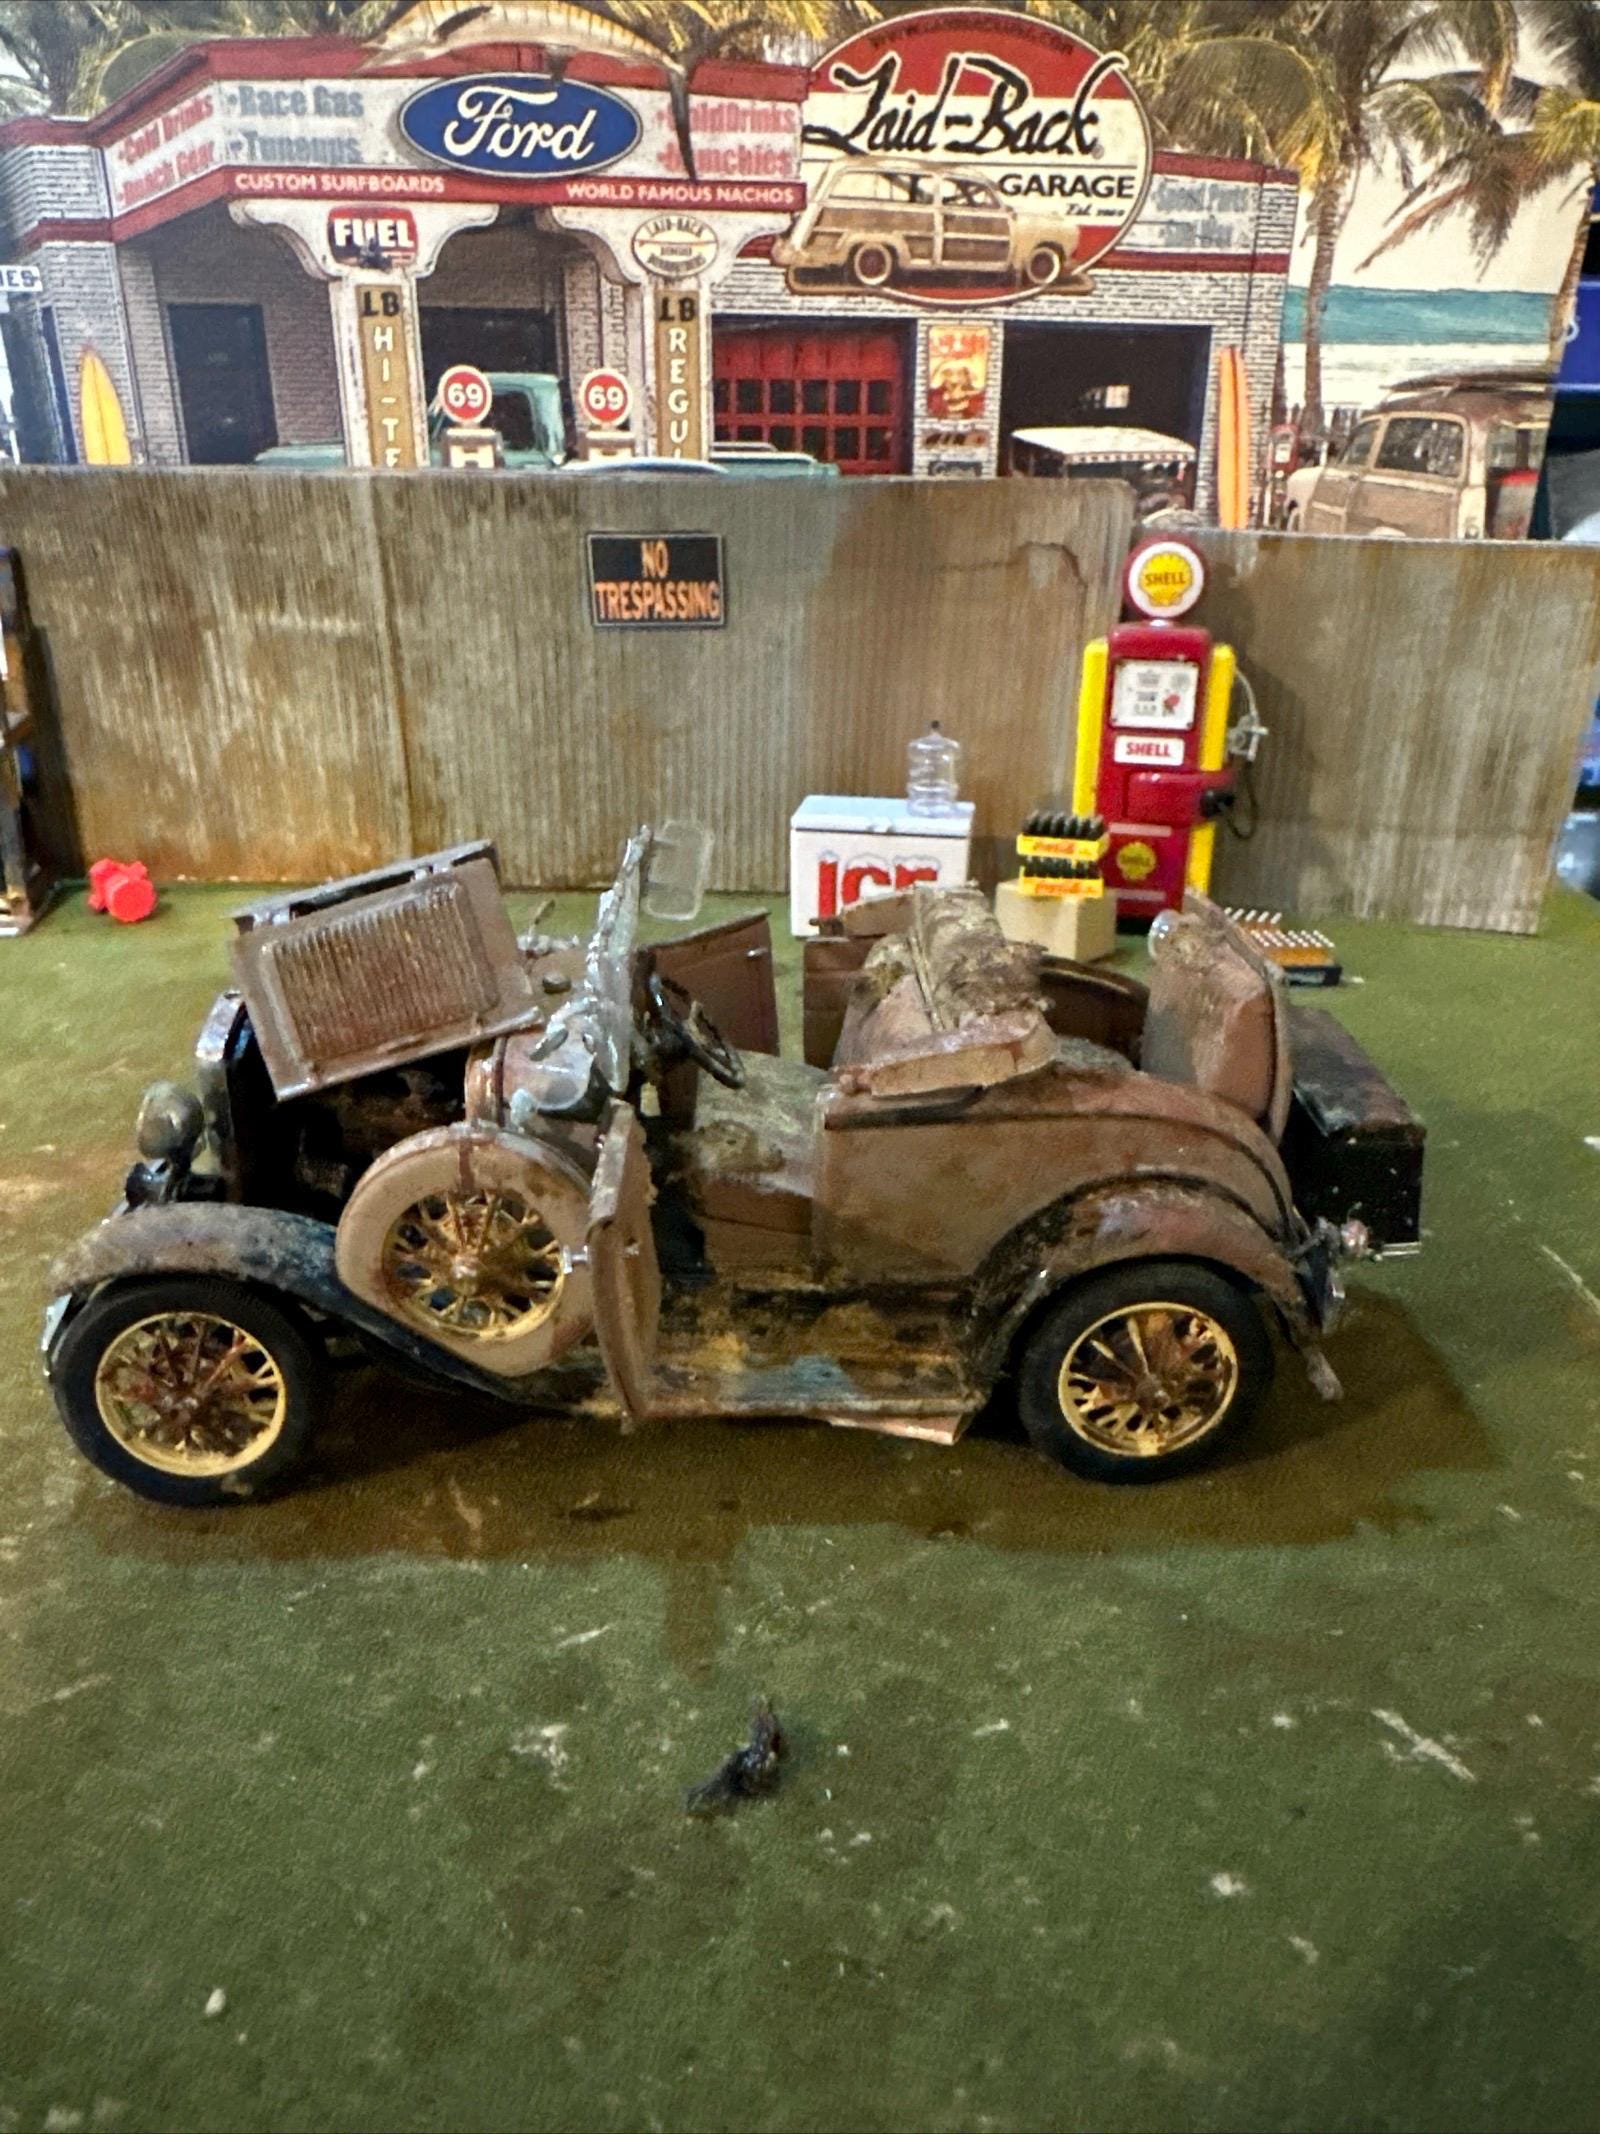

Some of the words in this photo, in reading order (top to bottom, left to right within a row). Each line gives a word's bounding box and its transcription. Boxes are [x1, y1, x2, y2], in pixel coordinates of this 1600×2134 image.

[239, 85, 307, 117] Race
[802, 54, 1127, 155] Laid-Back
[444, 85, 598, 160] Ford
[235, 174, 317, 190] CUSTOM
[321, 175, 445, 193] SURFBOARDS
[566, 183, 634, 200] WORLD
[638, 185, 713, 202] FAMOUS
[716, 187, 794, 204] NACHOS
[999, 174, 1135, 199] GARAGE
[333, 218, 414, 248] FUEL
[362, 291, 400, 317] LB
[660, 297, 697, 321] LB
[448, 382, 484, 408] 69
[588, 385, 625, 411] 69
[641, 540, 669, 578] NO
[1145, 571, 1186, 586] SHELL
[595, 580, 720, 620] TRESPASSING
[1126, 742, 1171, 758] SHELL
